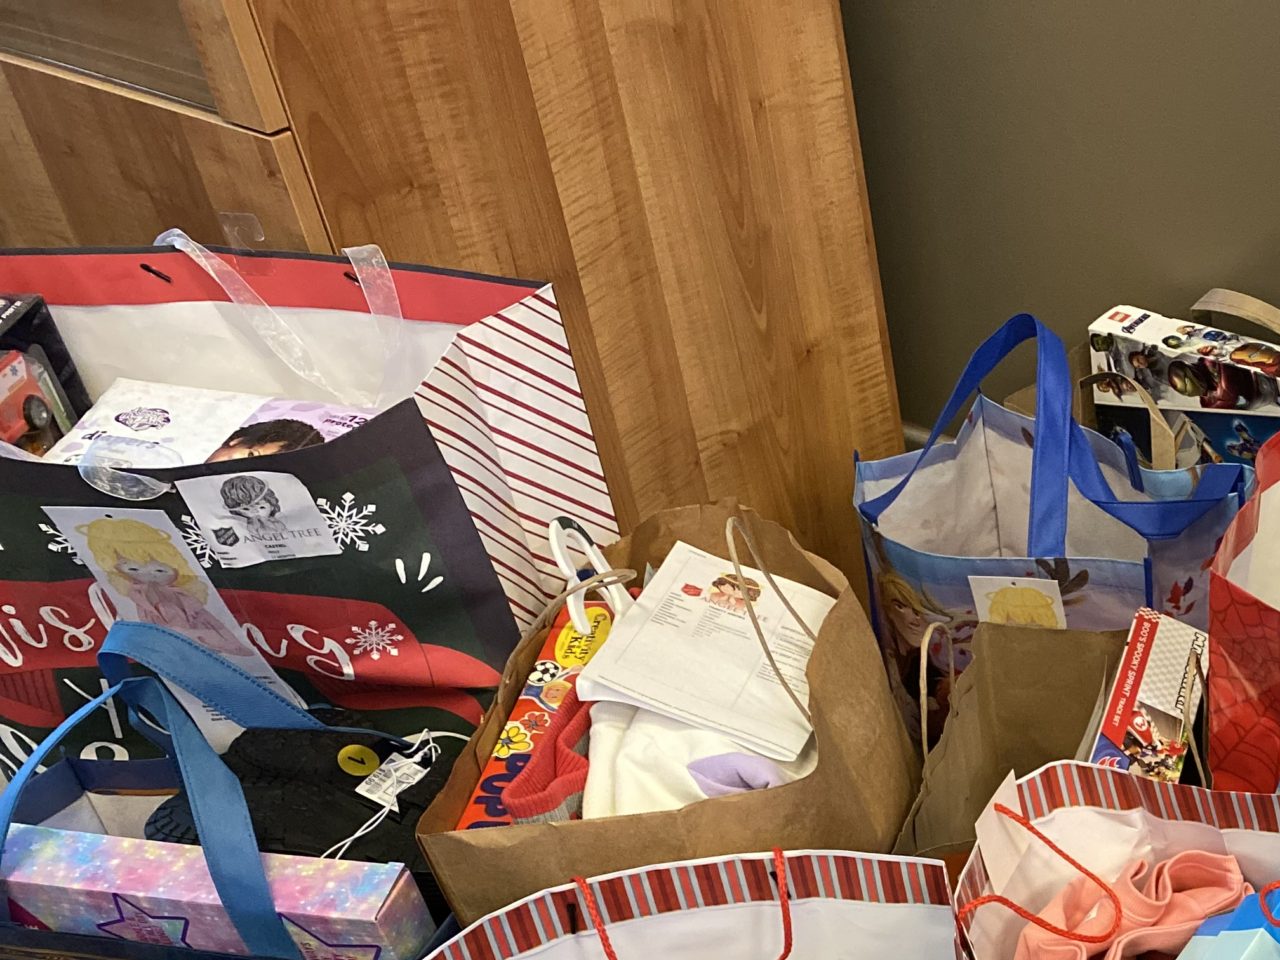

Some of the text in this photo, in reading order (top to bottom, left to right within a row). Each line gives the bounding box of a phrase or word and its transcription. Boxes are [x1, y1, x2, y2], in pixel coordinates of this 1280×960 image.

[243, 528, 322, 544] ANGEL TREE
[1131, 642, 1145, 670] SPOOKY
[1121, 670, 1137, 698] SPRINT
